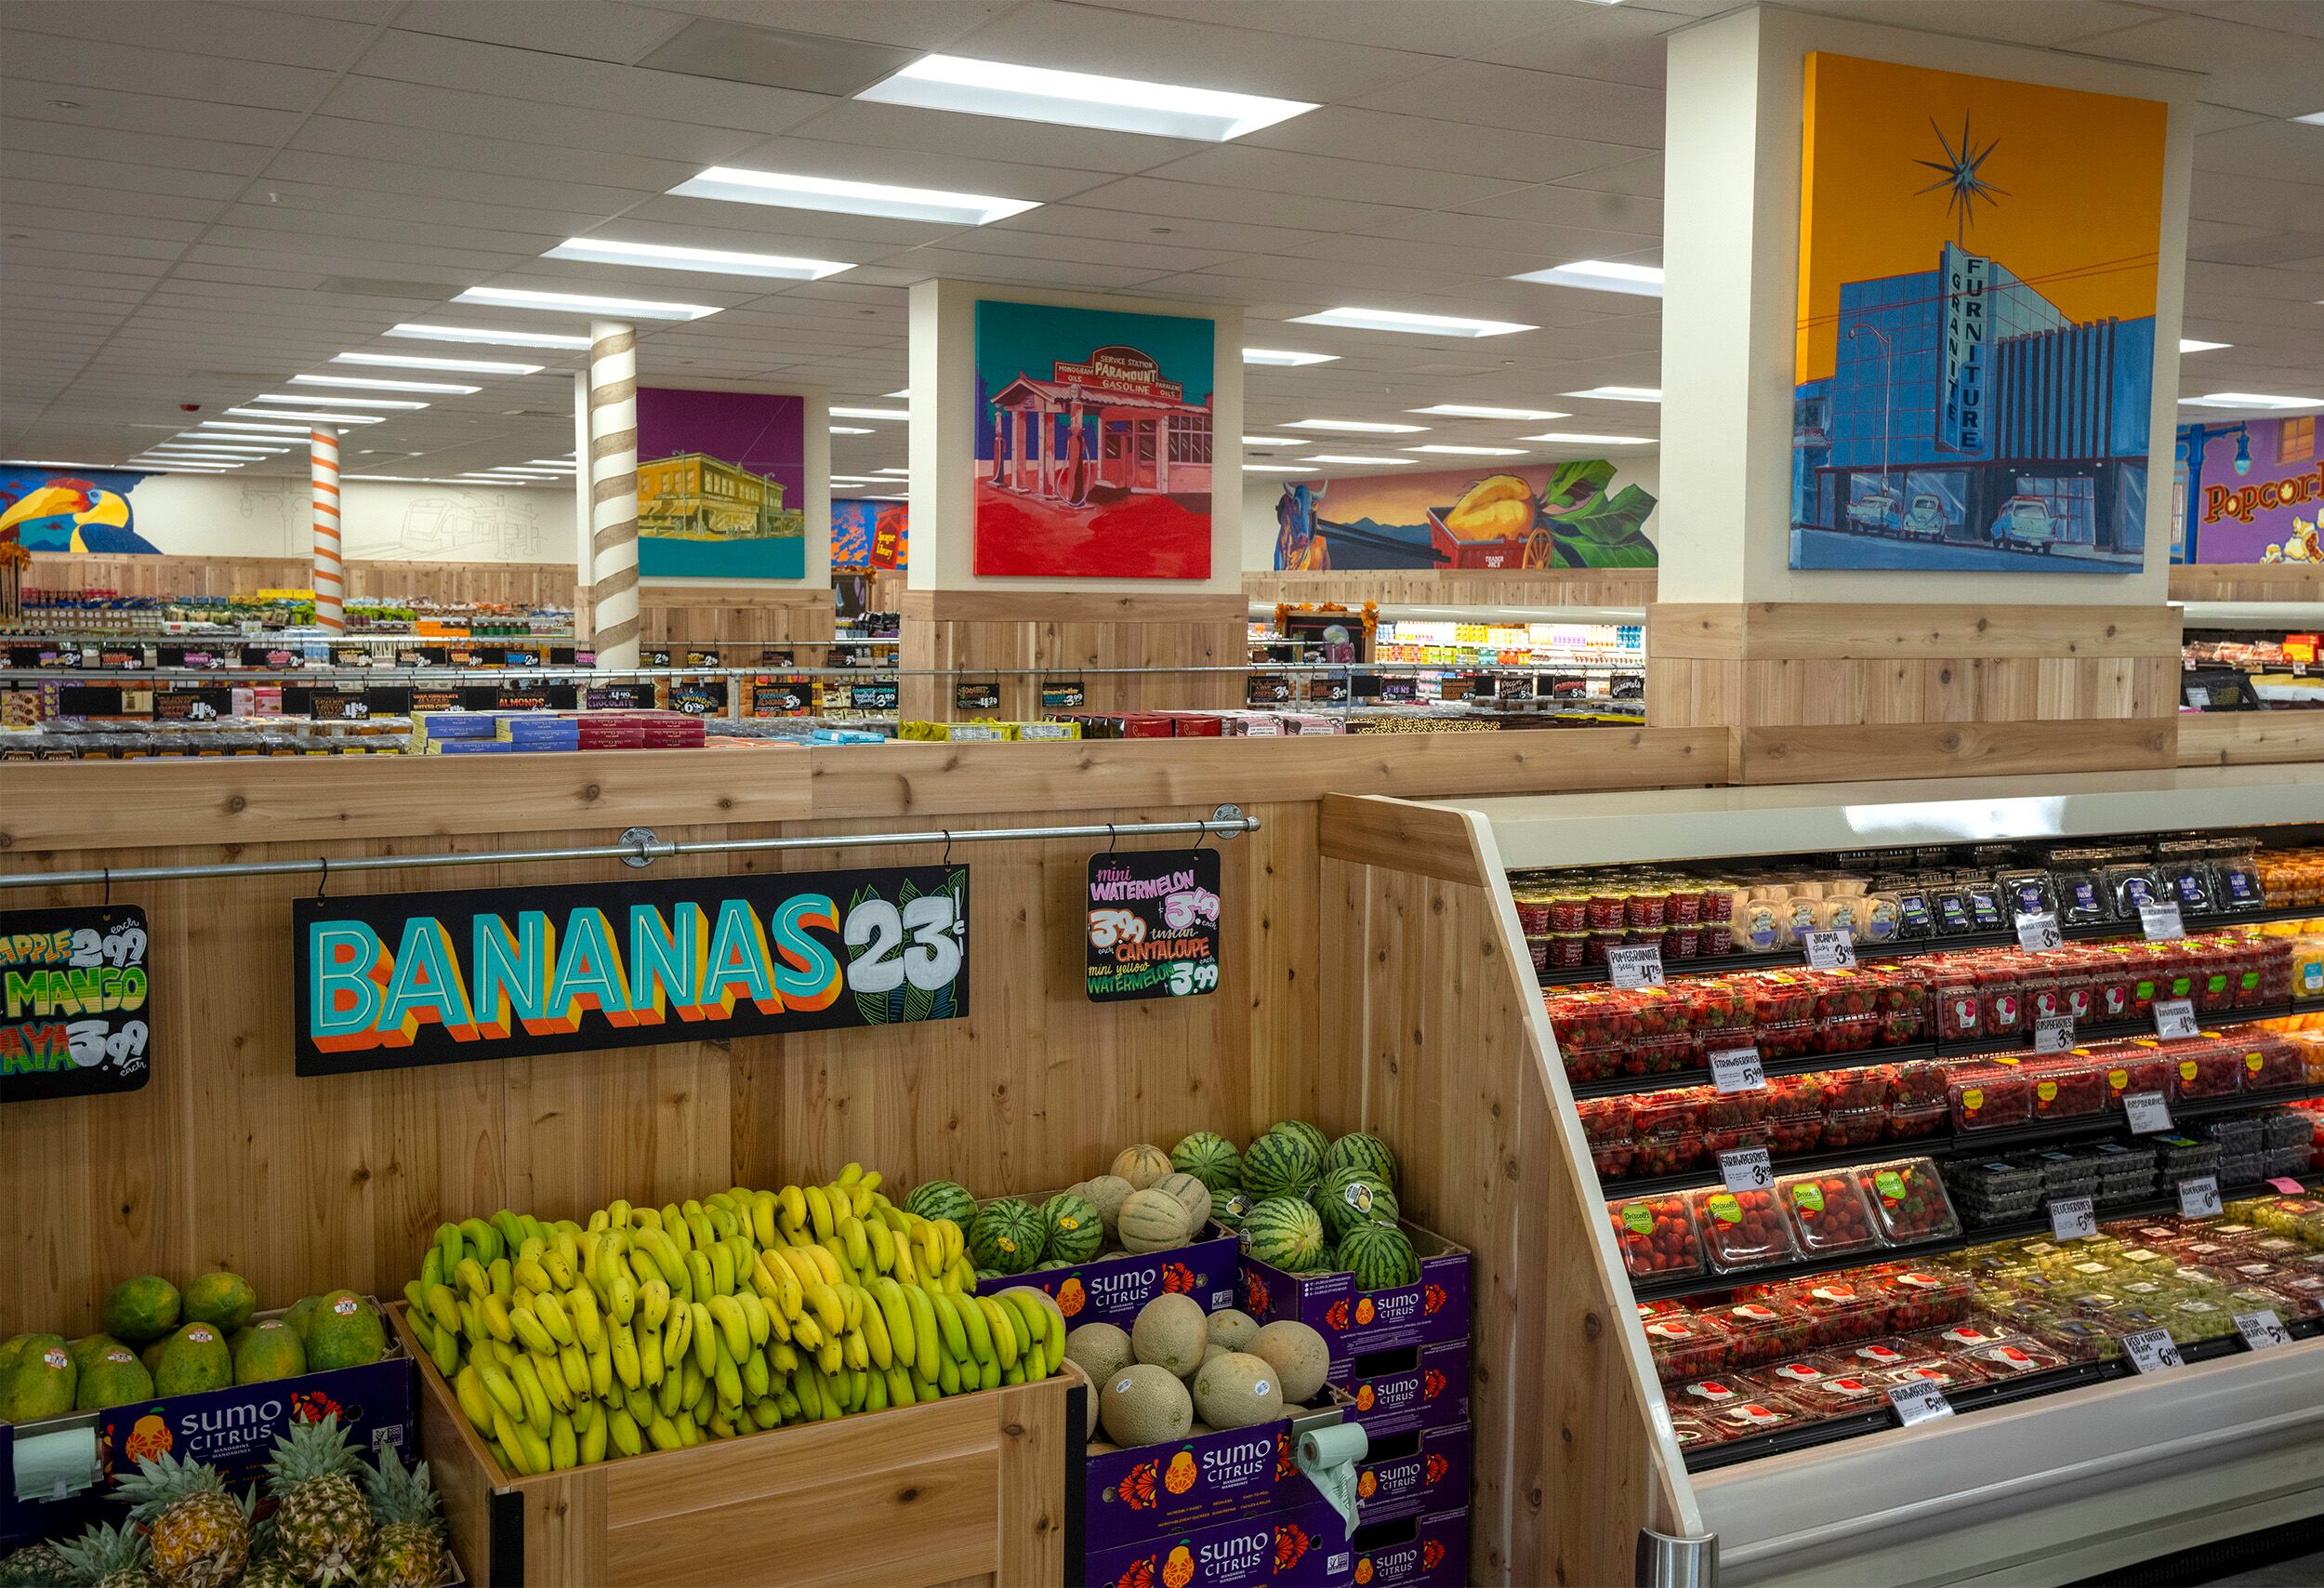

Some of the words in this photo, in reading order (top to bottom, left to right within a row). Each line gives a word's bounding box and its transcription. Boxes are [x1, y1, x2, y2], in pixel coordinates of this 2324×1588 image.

[1948, 273, 1961, 422] GRANITE
[1961, 258, 1983, 447] FURNITURE
[1100, 355, 1127, 365] SERVICE
[1128, 359, 1153, 369] STATION
[1059, 364, 1093, 376] MONOGRAM
[1095, 362, 1156, 382] PARAMOUNT
[1103, 379, 1150, 395] GASOLINE
[499, 698, 545, 708] ALMONDS
[675, 696, 712, 709] ALMONDS
[1096, 867, 1131, 881] mini
[1090, 869, 1195, 901] WATERMELON
[111, 918, 139, 933] each
[1201, 920, 1217, 930] each
[1150, 928, 1198, 940] tuscan
[1814, 933, 1840, 944] JICAMA
[1098, 946, 1114, 955] each
[1116, 937, 1210, 962] CANTALOUPE
[1610, 948, 1658, 963] POMEGRANATE
[1199, 955, 1216, 965] each
[310, 893, 841, 1053] BANANAS
[1088, 963, 1113, 976] mini
[1116, 961, 1150, 980] yellow
[1088, 961, 1175, 994] WATERMELON
[6, 966, 147, 1017] MANGO
[2158, 1006, 2190, 1017] RASPBERRIES
[2036, 1017, 2073, 1032] RASPBERRIES
[120, 1061, 147, 1077] each
[1714, 1055, 1759, 1068] STRAWBERRIES
[2127, 1097, 2164, 1109] RASPBERRIES
[1721, 1151, 1769, 1168] STRAWBERRIES
[1795, 1190, 1819, 1198] Driscoll's
[2182, 1184, 2212, 1197] BLUEBERRIES
[1711, 1201, 1737, 1210] Driscoll's
[2052, 1199, 2092, 1216] BLUEBERRIES
[1625, 1211, 1650, 1221] Driscoll's
[1095, 1288, 1149, 1307] CITRUS
[1380, 1305, 1414, 1318] CITRUS
[2238, 1318, 2260, 1330] GREEN
[2126, 1337, 2139, 1347] RED
[2146, 1331, 2166, 1342] GREEN
[2132, 1344, 2151, 1355] GRAPE
[1380, 1392, 1414, 1405] CITRUS
[1890, 1382, 1937, 1402] STRAWBERRIES
[190, 1423, 272, 1450] CITRUS
[1208, 1460, 1262, 1482] CITRUS
[1382, 1476, 1416, 1490] CITRUS
[1205, 1553, 1261, 1577] CITRUS
[1379, 1563, 1413, 1578] CITRUS
